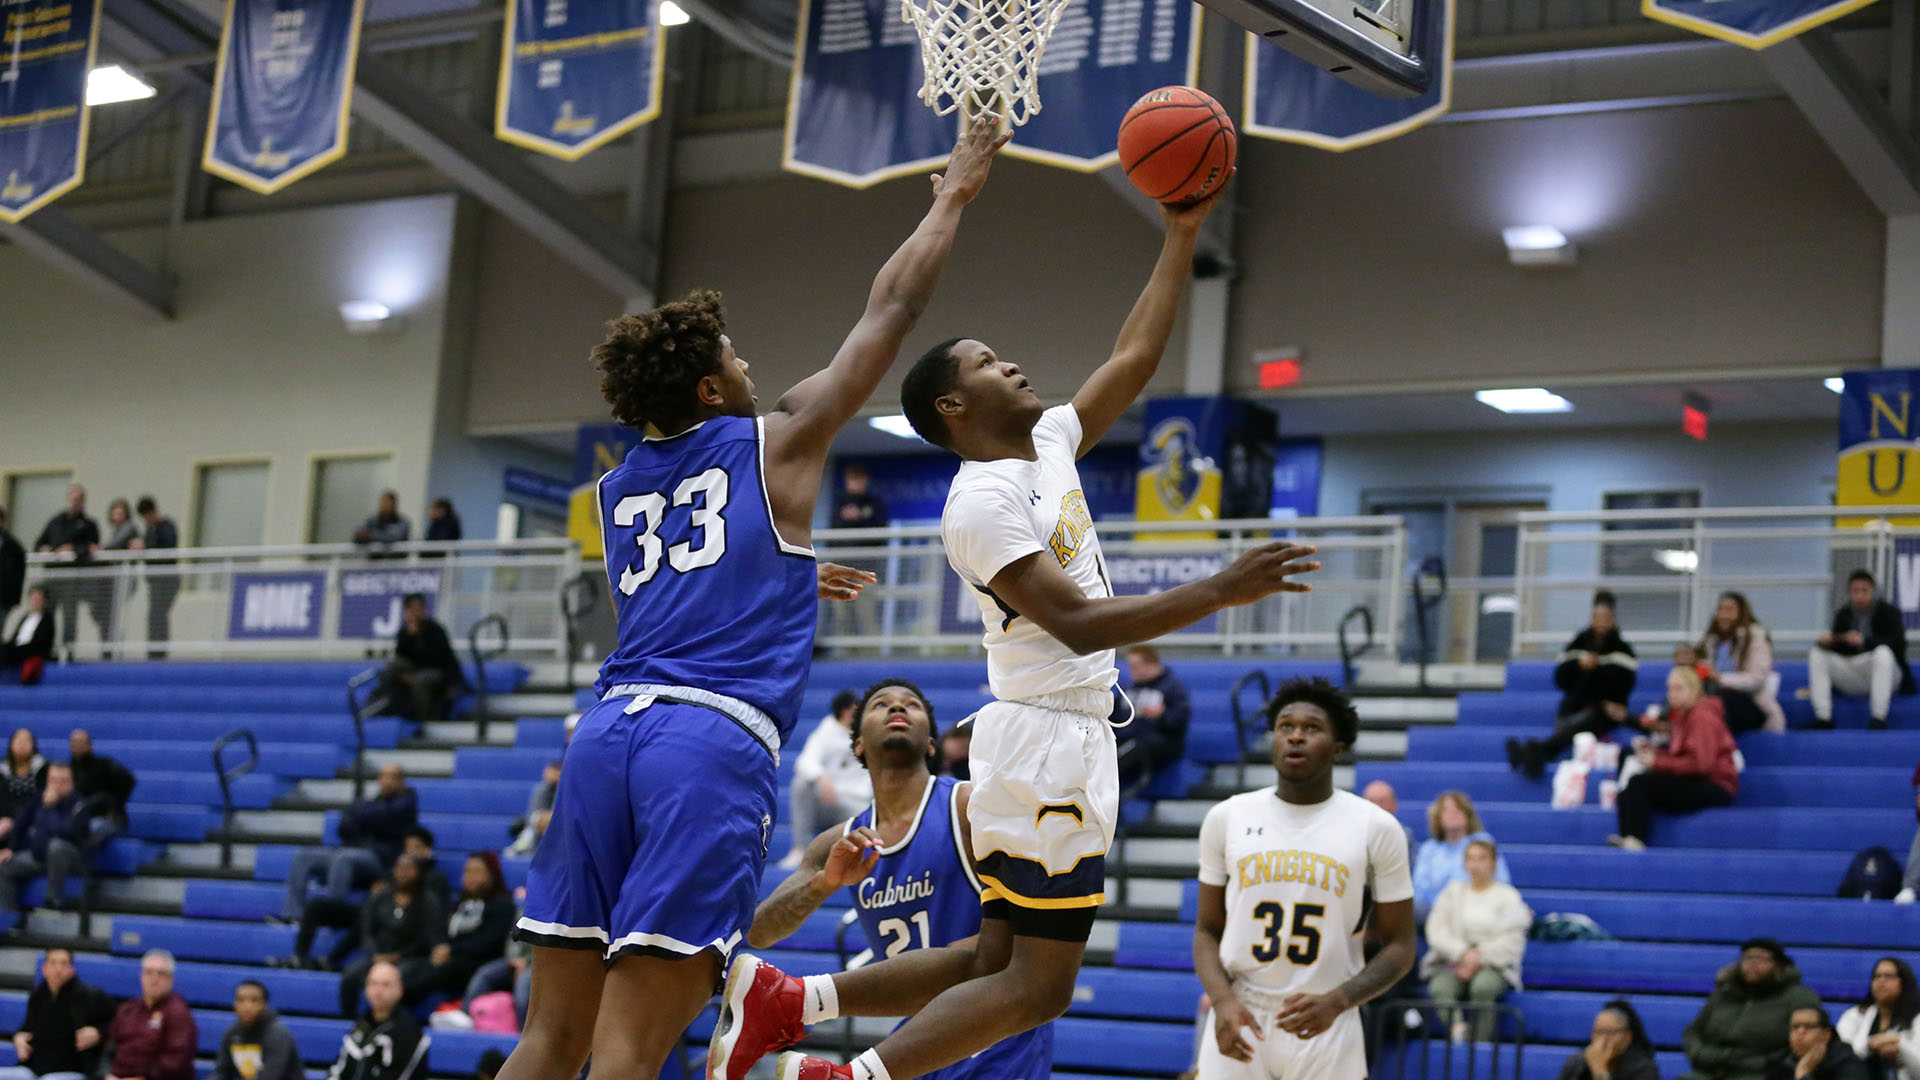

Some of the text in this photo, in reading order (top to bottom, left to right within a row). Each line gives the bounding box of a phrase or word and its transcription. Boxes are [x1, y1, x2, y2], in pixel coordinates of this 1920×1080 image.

[1868, 391, 1910, 439] N
[1867, 452, 1906, 496] U
[613, 467, 729, 596] 33
[372, 597, 401, 637] J
[858, 870, 935, 910] Cabrini
[1236, 849, 1350, 898] KNIGHTS
[878, 910, 930, 959] 21
[1250, 899, 1327, 967] 35
